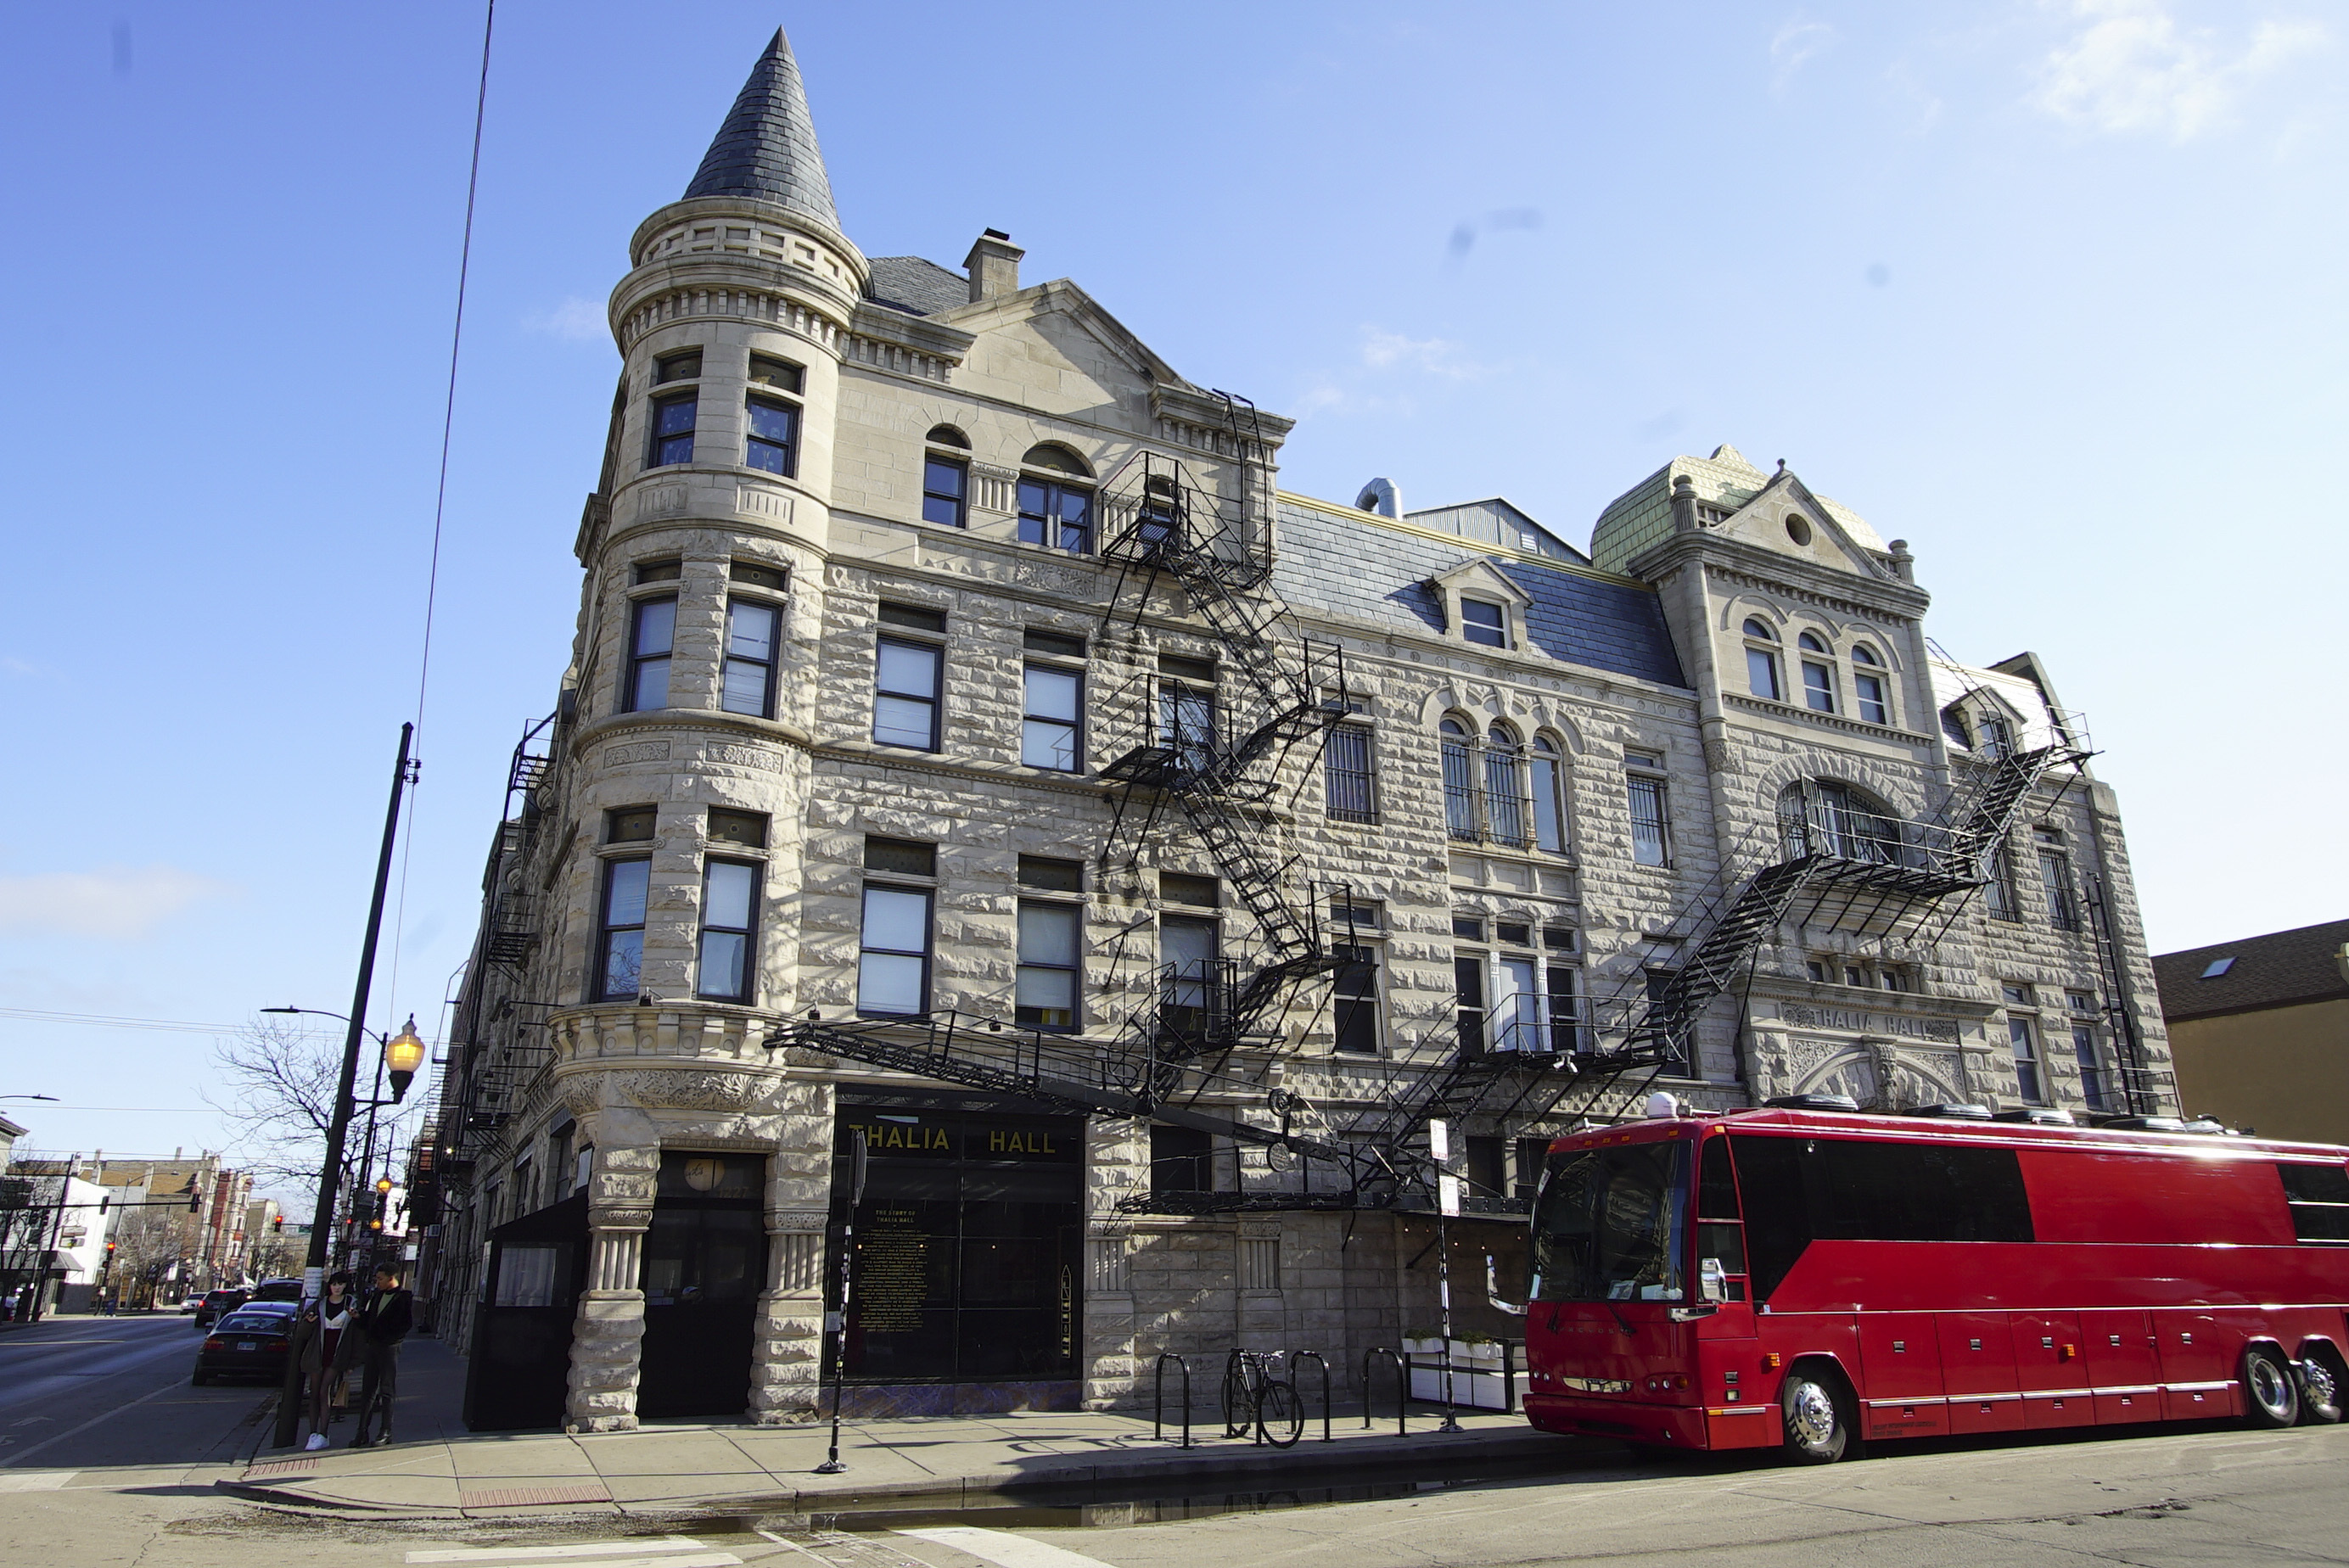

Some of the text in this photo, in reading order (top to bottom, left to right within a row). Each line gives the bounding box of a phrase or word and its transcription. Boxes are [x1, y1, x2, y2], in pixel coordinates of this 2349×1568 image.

[1809, 1008, 1933, 1039] THALIA HALL
[989, 1130, 1056, 1154] HALL
